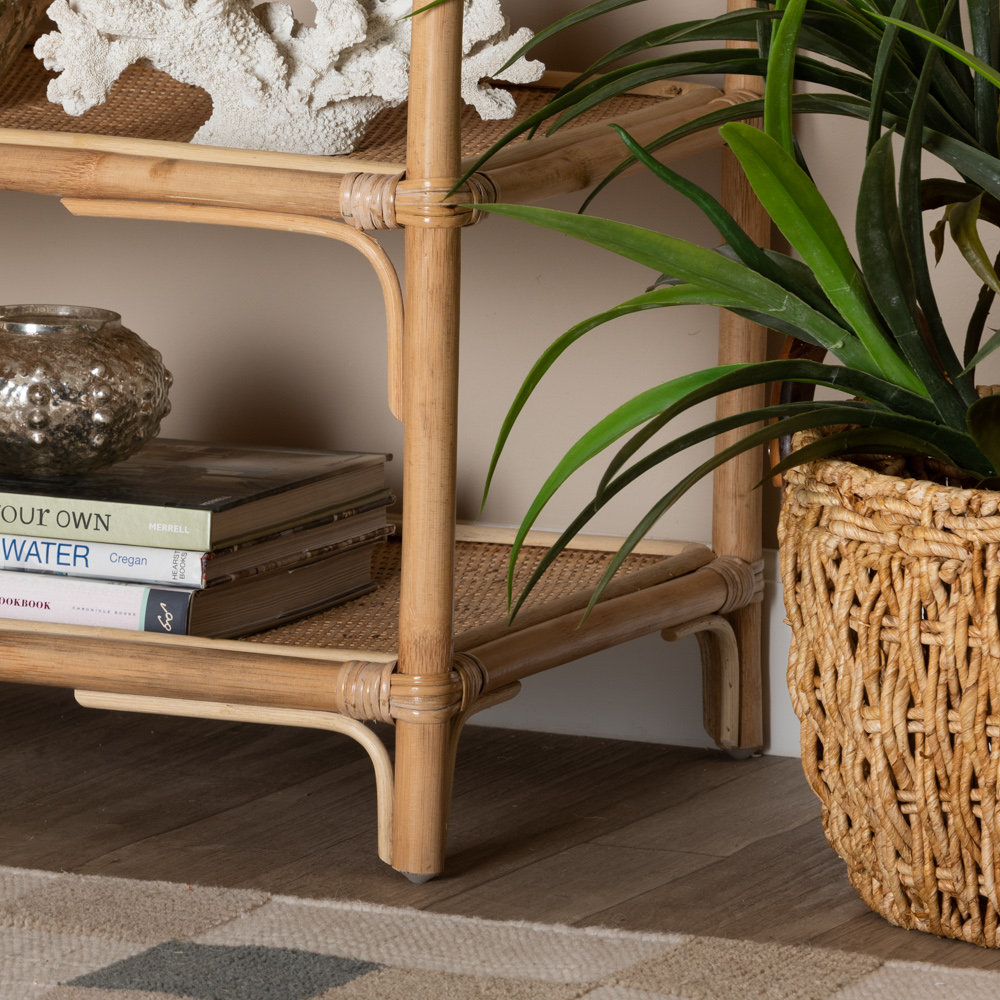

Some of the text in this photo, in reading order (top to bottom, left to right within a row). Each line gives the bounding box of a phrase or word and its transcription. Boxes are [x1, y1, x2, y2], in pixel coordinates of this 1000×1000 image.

[56, 510, 112, 531] OWN
[148, 522, 190, 534] MERRELL
[2, 538, 90, 568] WATER
[109, 552, 148, 567] Cregan
[172, 550, 181, 580] HEARST
[179, 551, 188, 579] BOOKS
